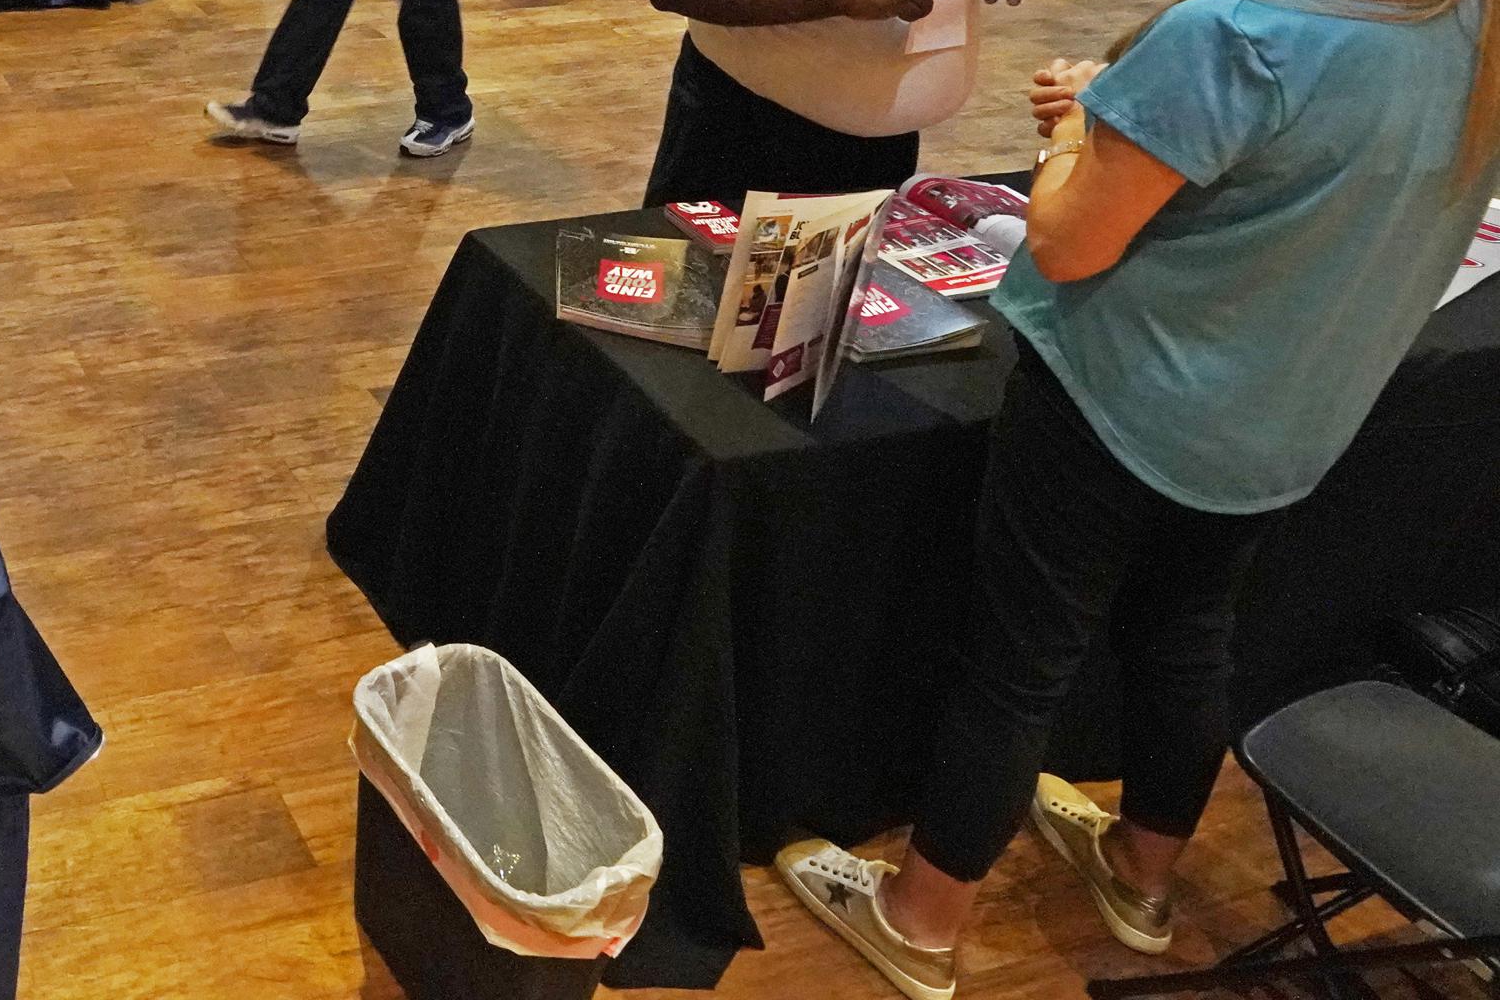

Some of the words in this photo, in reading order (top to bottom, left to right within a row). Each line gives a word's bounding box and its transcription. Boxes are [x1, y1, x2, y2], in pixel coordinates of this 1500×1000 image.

[606, 266, 653, 280] WAY
[604, 274, 657, 289] YOUR
[605, 283, 656, 299] FIND
